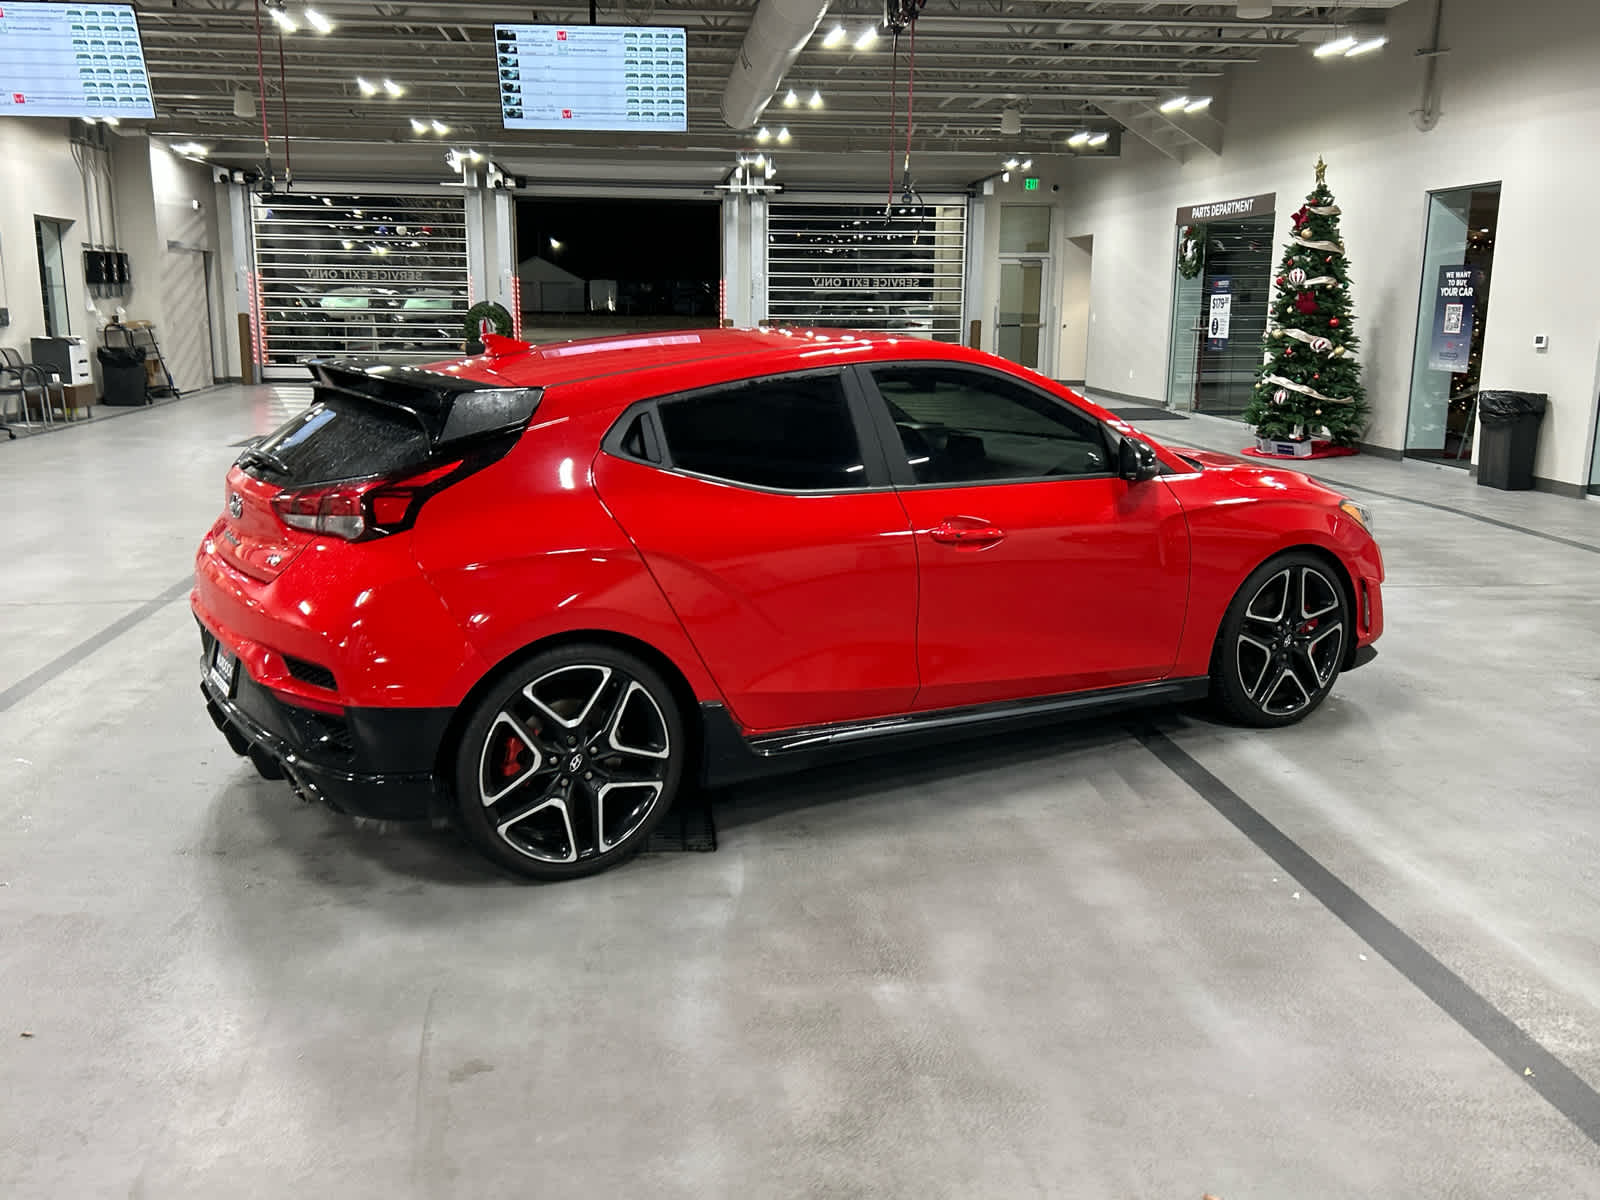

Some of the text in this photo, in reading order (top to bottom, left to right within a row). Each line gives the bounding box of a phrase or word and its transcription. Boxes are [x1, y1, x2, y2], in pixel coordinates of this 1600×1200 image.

[1025, 178, 1039, 190] EXIT
[1192, 199, 1254, 218] PARTS DEPARTMENT
[1456, 279, 1468, 287] BUY
[1440, 287, 1474, 296] YOUR CAR
